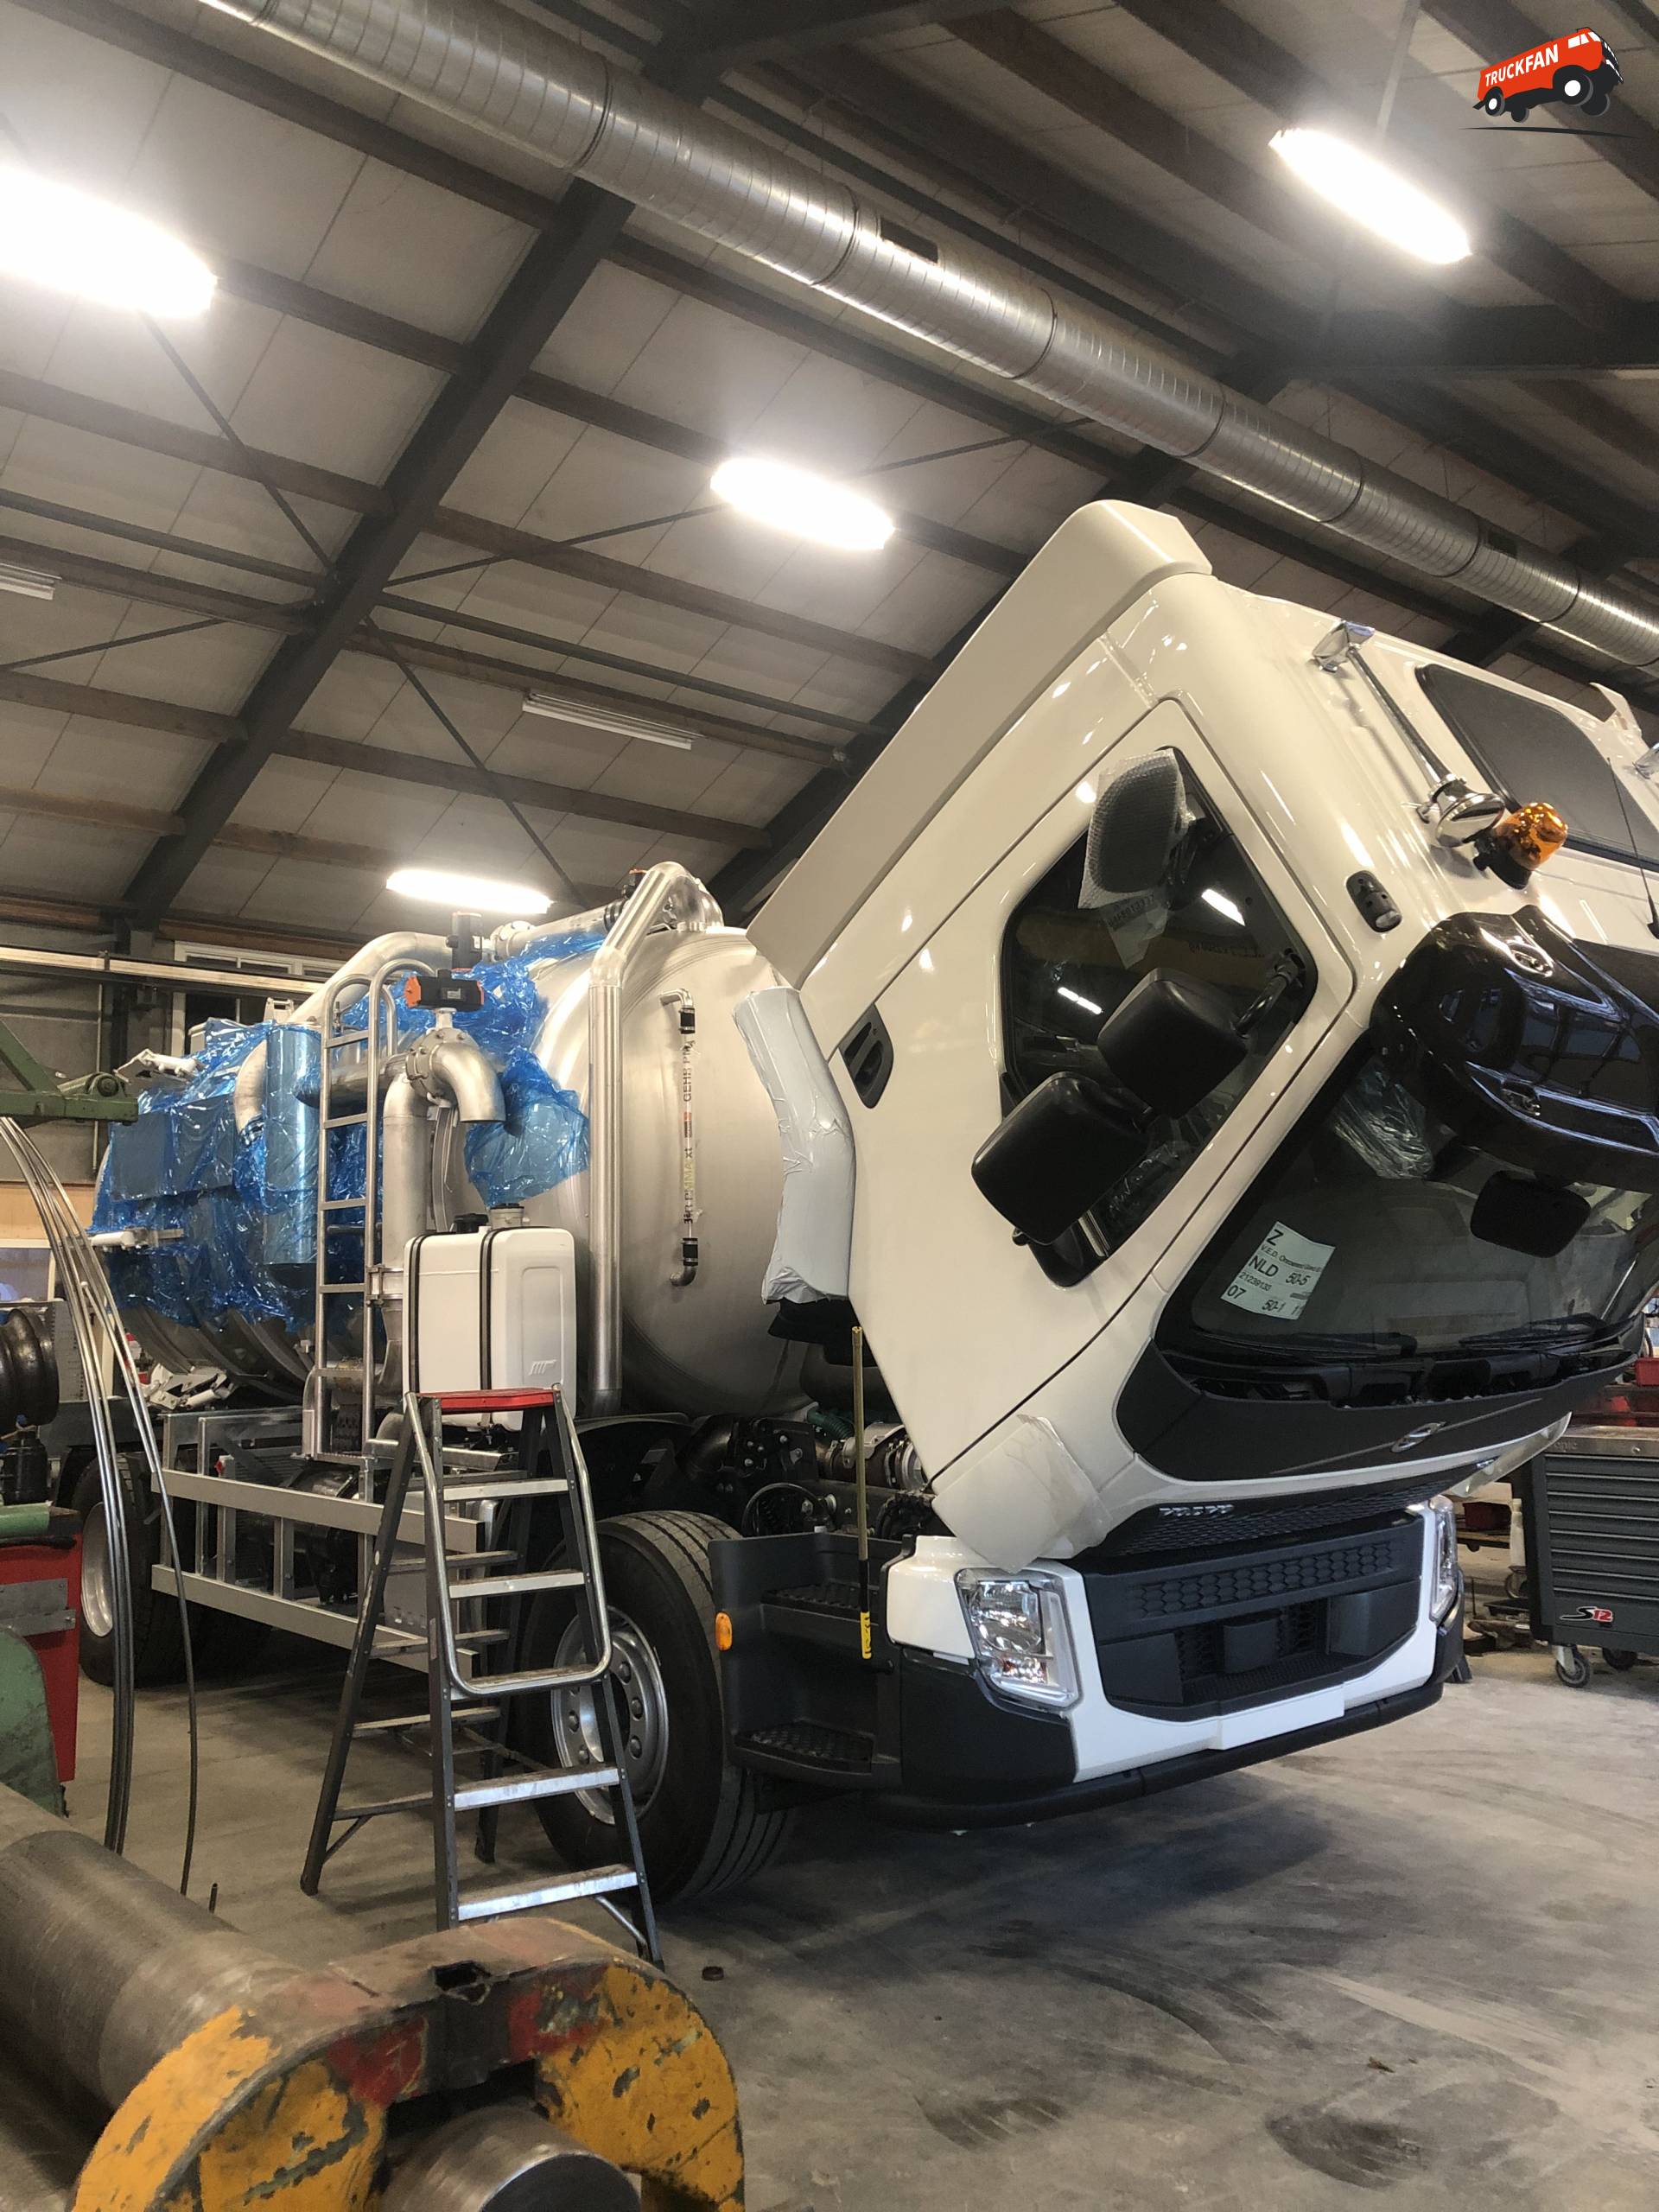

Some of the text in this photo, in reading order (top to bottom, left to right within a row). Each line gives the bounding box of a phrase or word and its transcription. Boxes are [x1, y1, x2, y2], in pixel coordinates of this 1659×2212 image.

[1266, 1229, 1284, 1246] Z
[1249, 1255, 1279, 1276] NLD
[1227, 1285, 1247, 1300] 07
